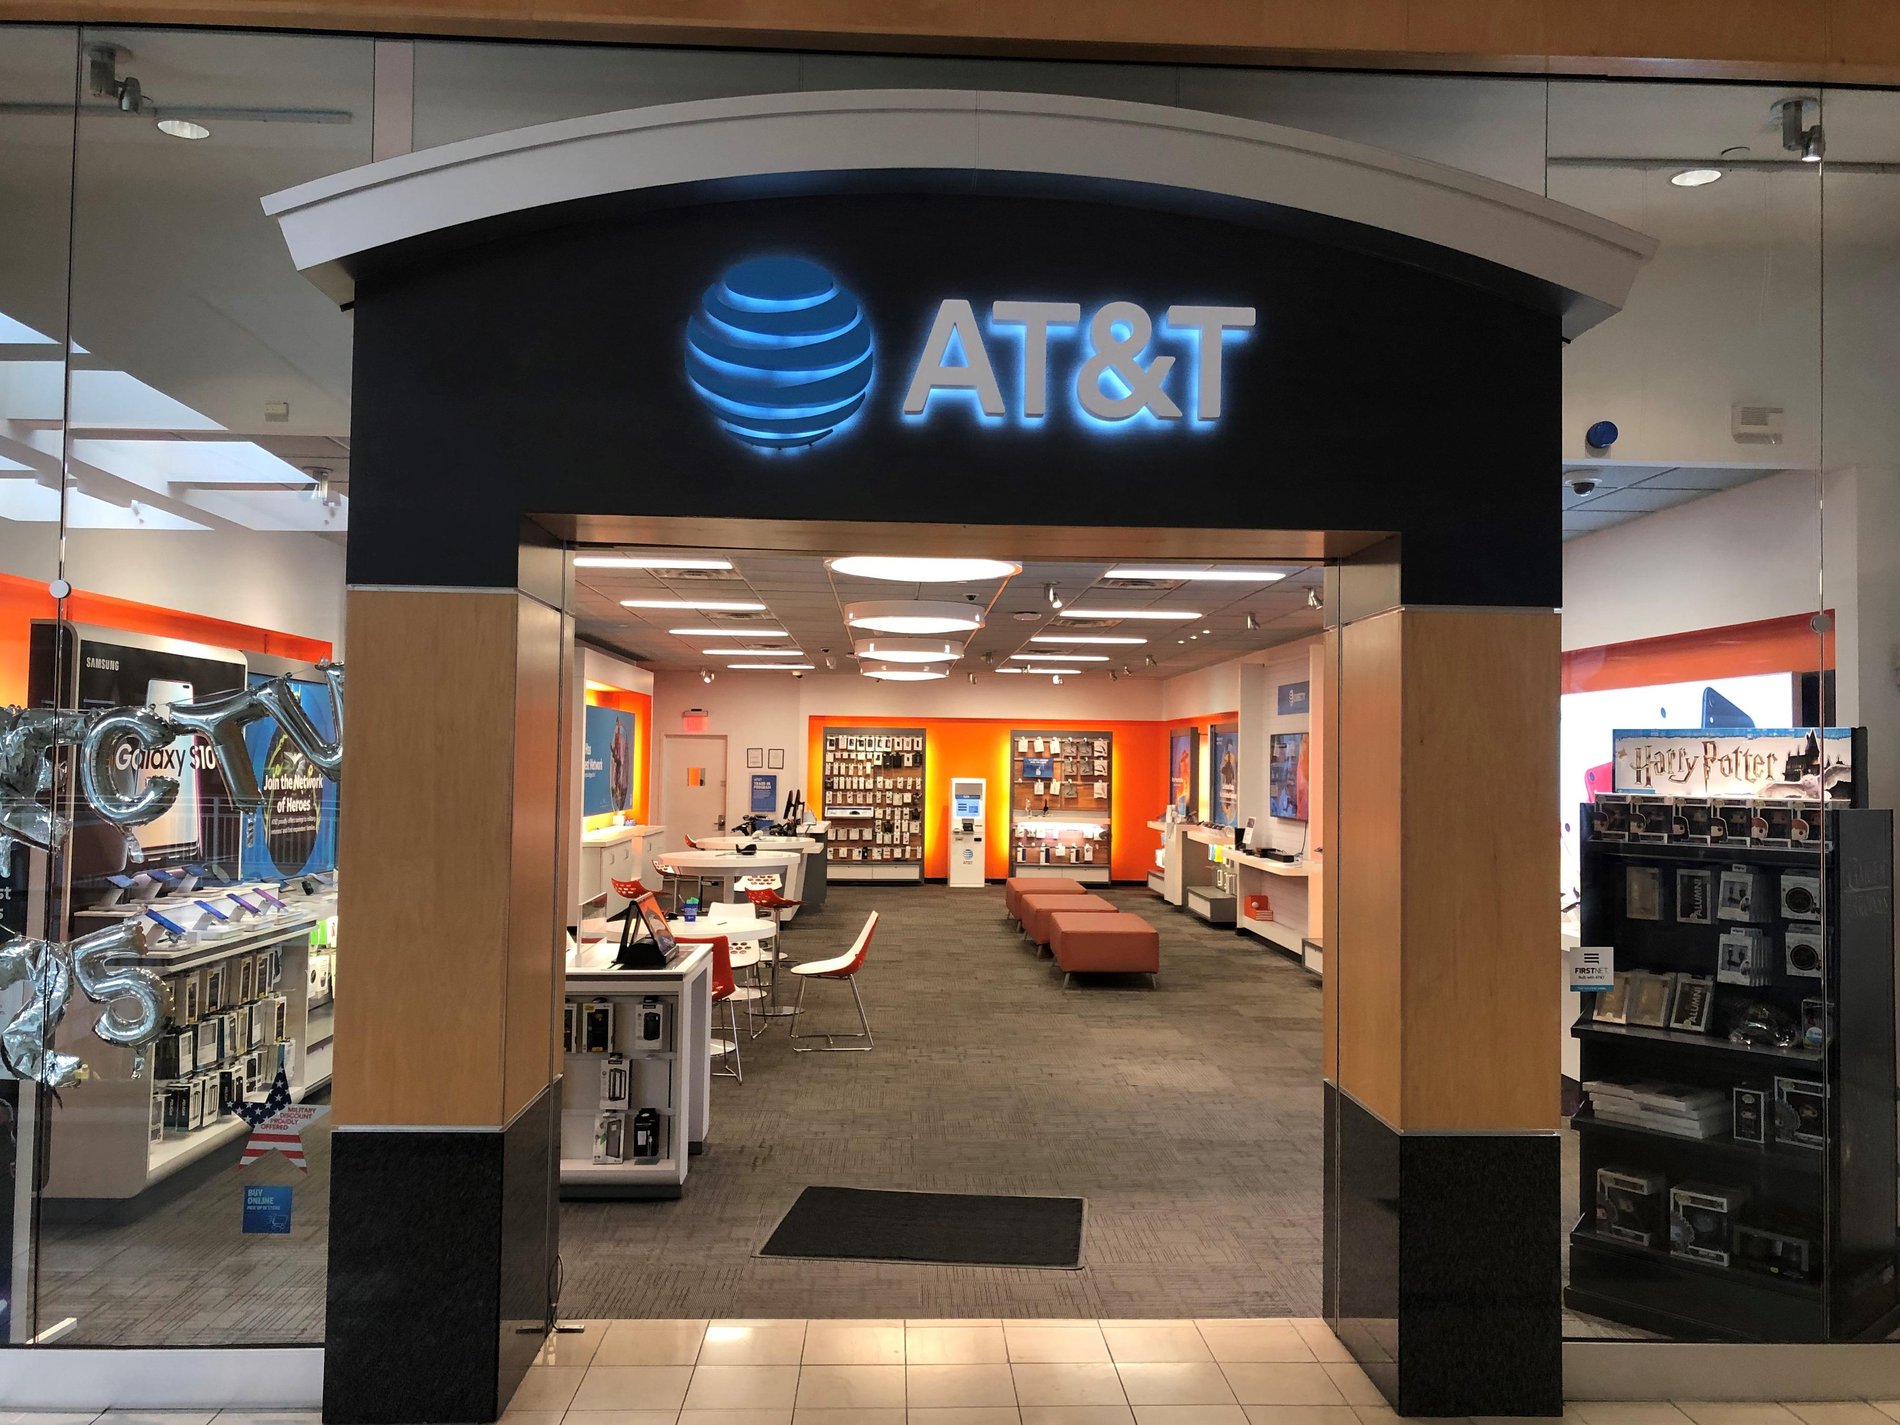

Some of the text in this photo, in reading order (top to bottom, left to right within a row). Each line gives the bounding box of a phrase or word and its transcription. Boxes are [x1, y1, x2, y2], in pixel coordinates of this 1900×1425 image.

[903, 298, 1256, 422] AT&T
[86, 656, 120, 671] SAMSUNG
[115, 743, 217, 777] Galaxy S10
[1630, 740, 1778, 793] Harry Potter
[264, 773, 323, 791] Join the Network
[277, 796, 311, 813] of Heroes
[1688, 985, 1703, 1023] ALUMNI
[287, 1106, 317, 1114] MILITARY
[260, 1123, 289, 1131] OFFERED
[270, 1118, 300, 1126] PROUDLY
[247, 1188, 263, 1197] BUY
